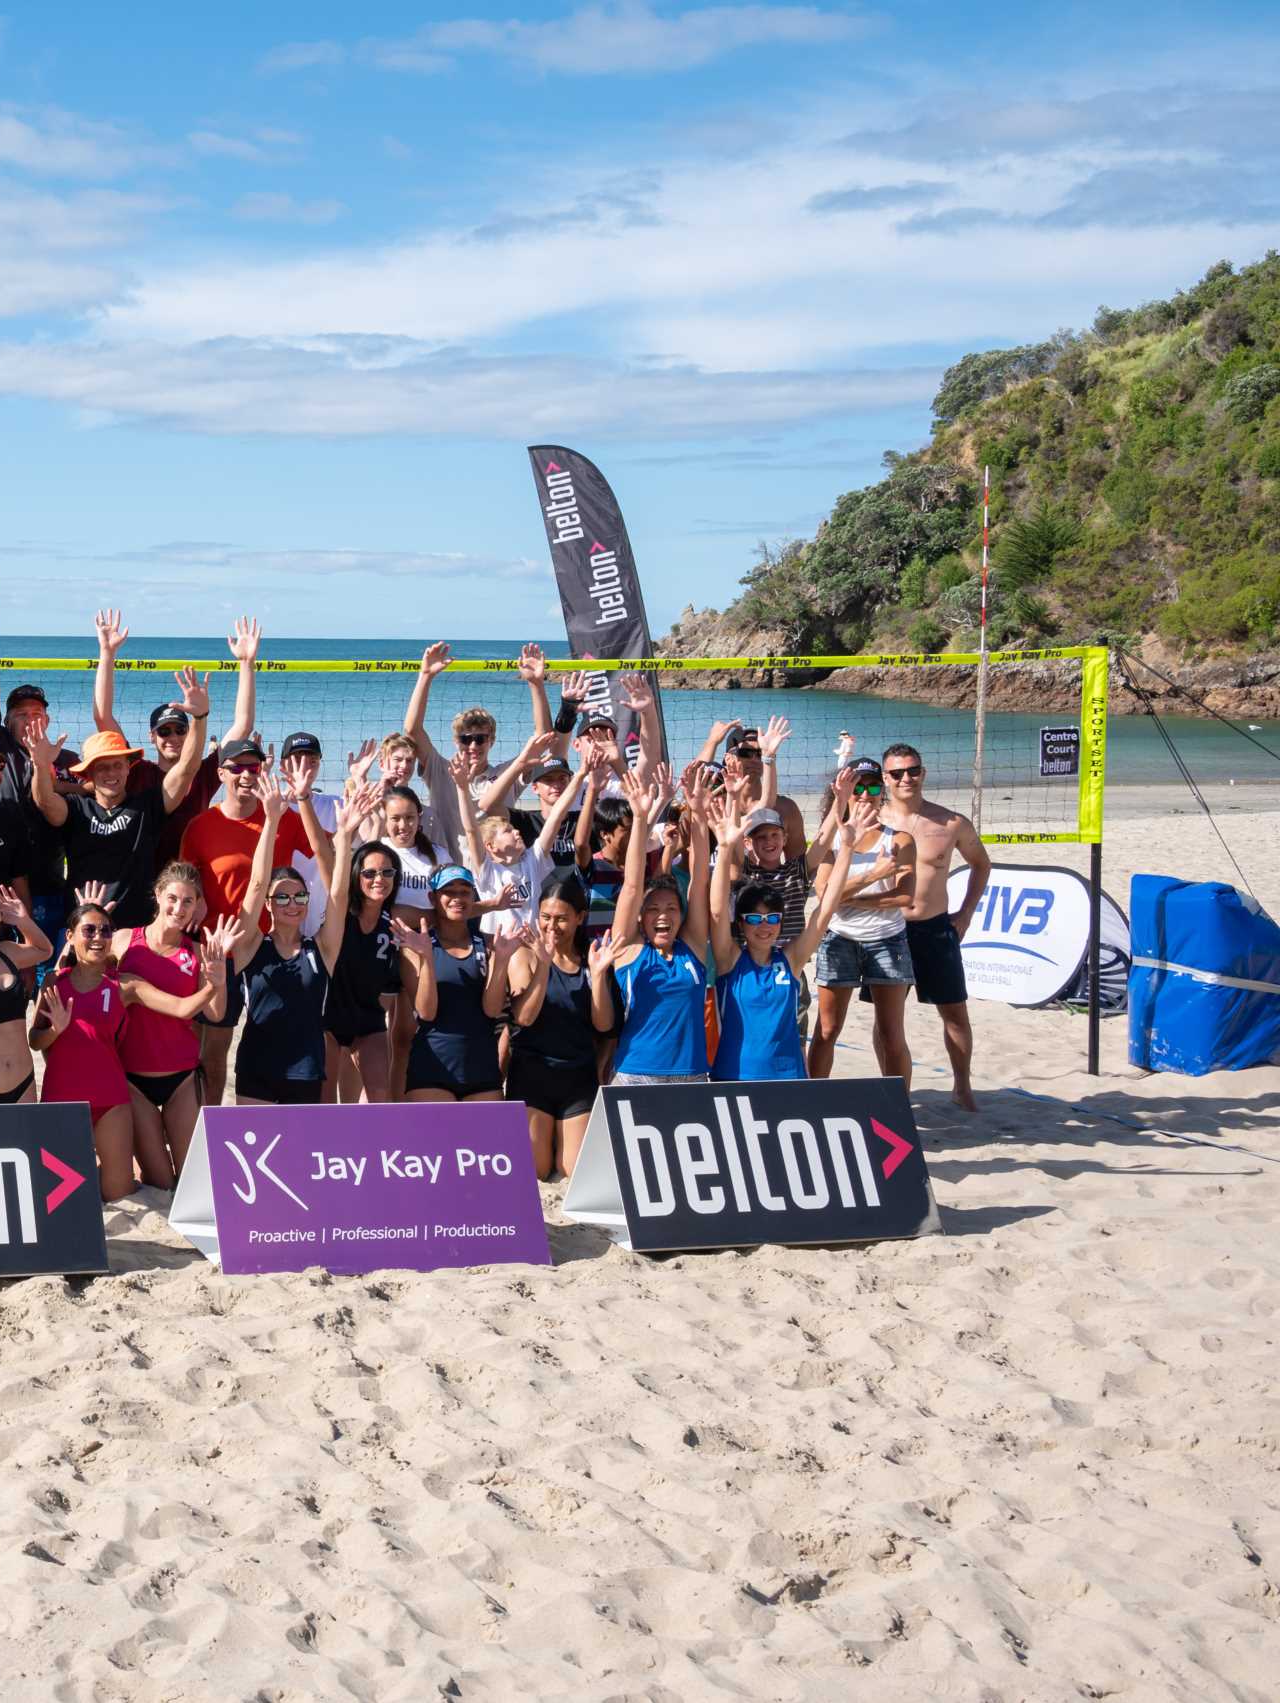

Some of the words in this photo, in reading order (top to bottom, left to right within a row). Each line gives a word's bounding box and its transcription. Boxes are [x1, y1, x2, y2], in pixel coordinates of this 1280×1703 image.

[546, 471, 584, 545] belton
[589, 551, 627, 626] belton
[747, 658, 765, 668] Jay
[769, 657, 789, 668] Kay
[793, 657, 811, 666] Pro
[878, 656, 895, 666] Jay
[899, 655, 919, 665] Kay
[923, 654, 942, 664] Pro
[999, 652, 1017, 662] Jay
[1021, 651, 1040, 661] Kay
[1044, 649, 1062, 659] Pro
[137, 660, 157, 669] Pro
[218, 661, 237, 671] Jay
[267, 661, 287, 670] Pro
[353, 661, 371, 671] Jay
[376, 661, 396, 671] Kay
[401, 661, 420, 670] Pro
[483, 661, 501, 671] Jay
[618, 659, 636, 670] Jay
[640, 659, 660, 670] Kay
[664, 659, 683, 669] Pro
[1043, 731, 1078, 742] Centre
[1090, 697, 1105, 778] SPORTSET
[1046, 744, 1075, 754] Court
[1043, 758, 1071, 774] belton
[996, 834, 1014, 844] Jay
[1017, 833, 1036, 843] Kay
[1040, 832, 1057, 842] Pro
[179, 952, 193, 976] 2
[684, 960, 700, 985] 1
[773, 961, 791, 985] 2
[101, 988, 112, 1013] 1
[617, 1095, 881, 1218] belton
[311, 1151, 367, 1186] Jay
[380, 1150, 442, 1184] Kay
[455, 1148, 512, 1177] Pro
[249, 1229, 316, 1243] Proactive
[332, 1225, 418, 1241] Professional
[434, 1223, 516, 1238] Productions
